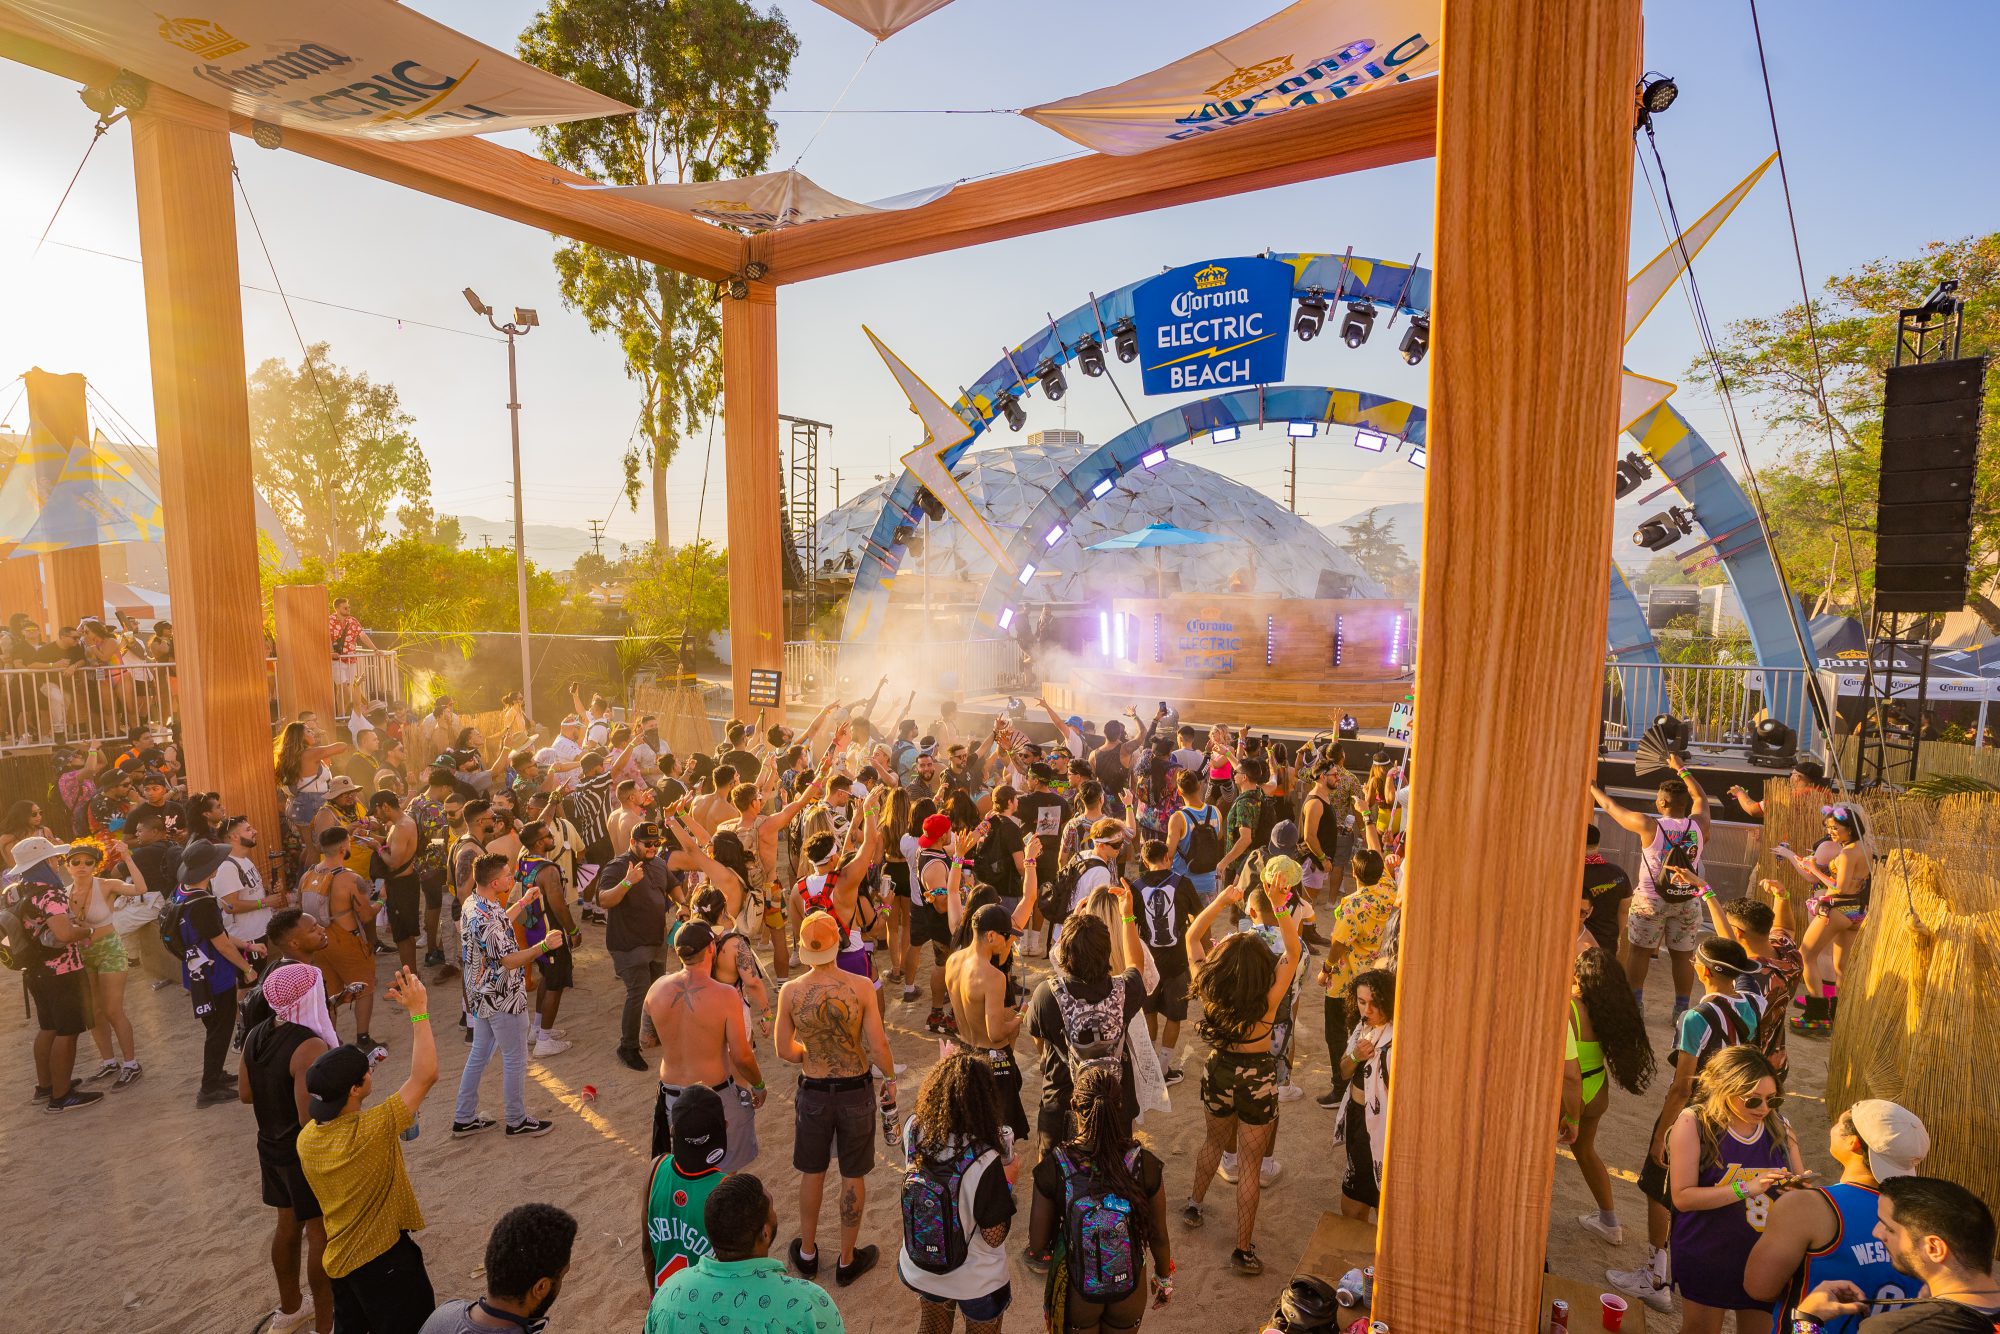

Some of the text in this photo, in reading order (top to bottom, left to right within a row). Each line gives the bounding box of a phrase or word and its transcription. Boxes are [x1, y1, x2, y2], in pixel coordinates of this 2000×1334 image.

[193, 43, 352, 98] Corona
[278, 60, 460, 122] ECTRIC
[1171, 288, 1249, 318] Corona
[1158, 312, 1263, 348] ELECTRIC
[1171, 358, 1250, 388] BEACH
[1186, 619, 1232, 634] Corona
[1179, 637, 1241, 651] ELECTRIC
[1185, 655, 1232, 671] BEACH
[1939, 683, 1974, 692] Corona
[1745, 1192, 1775, 1233] 8
